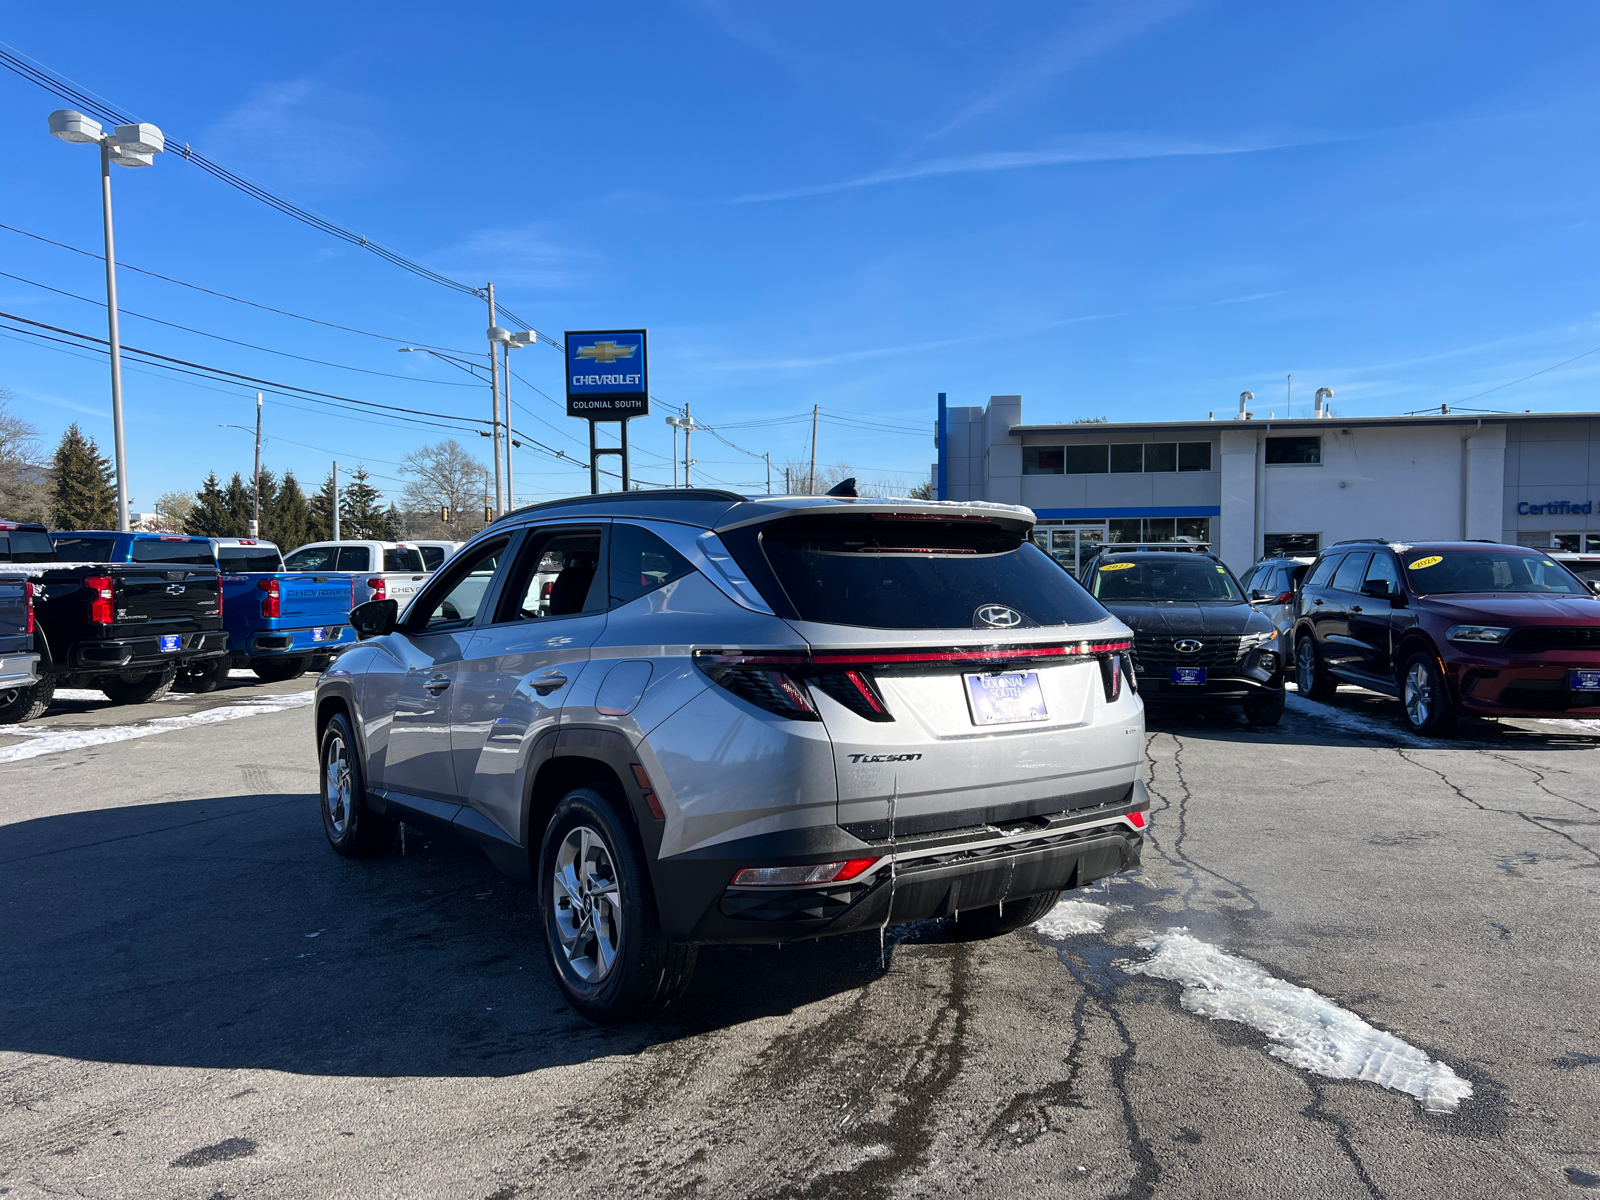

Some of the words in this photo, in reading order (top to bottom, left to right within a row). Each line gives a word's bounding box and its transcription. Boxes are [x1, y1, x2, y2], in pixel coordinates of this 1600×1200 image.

[573, 374, 641, 386] CHEVROLET
[573, 401, 612, 409] COLONIAL
[615, 400, 642, 408] SOUTH
[1518, 501, 1592, 515] Certified
[1415, 557, 1437, 568] 2024
[981, 678, 1026, 689] COLONIAL
[990, 687, 1021, 698] SOUTH
